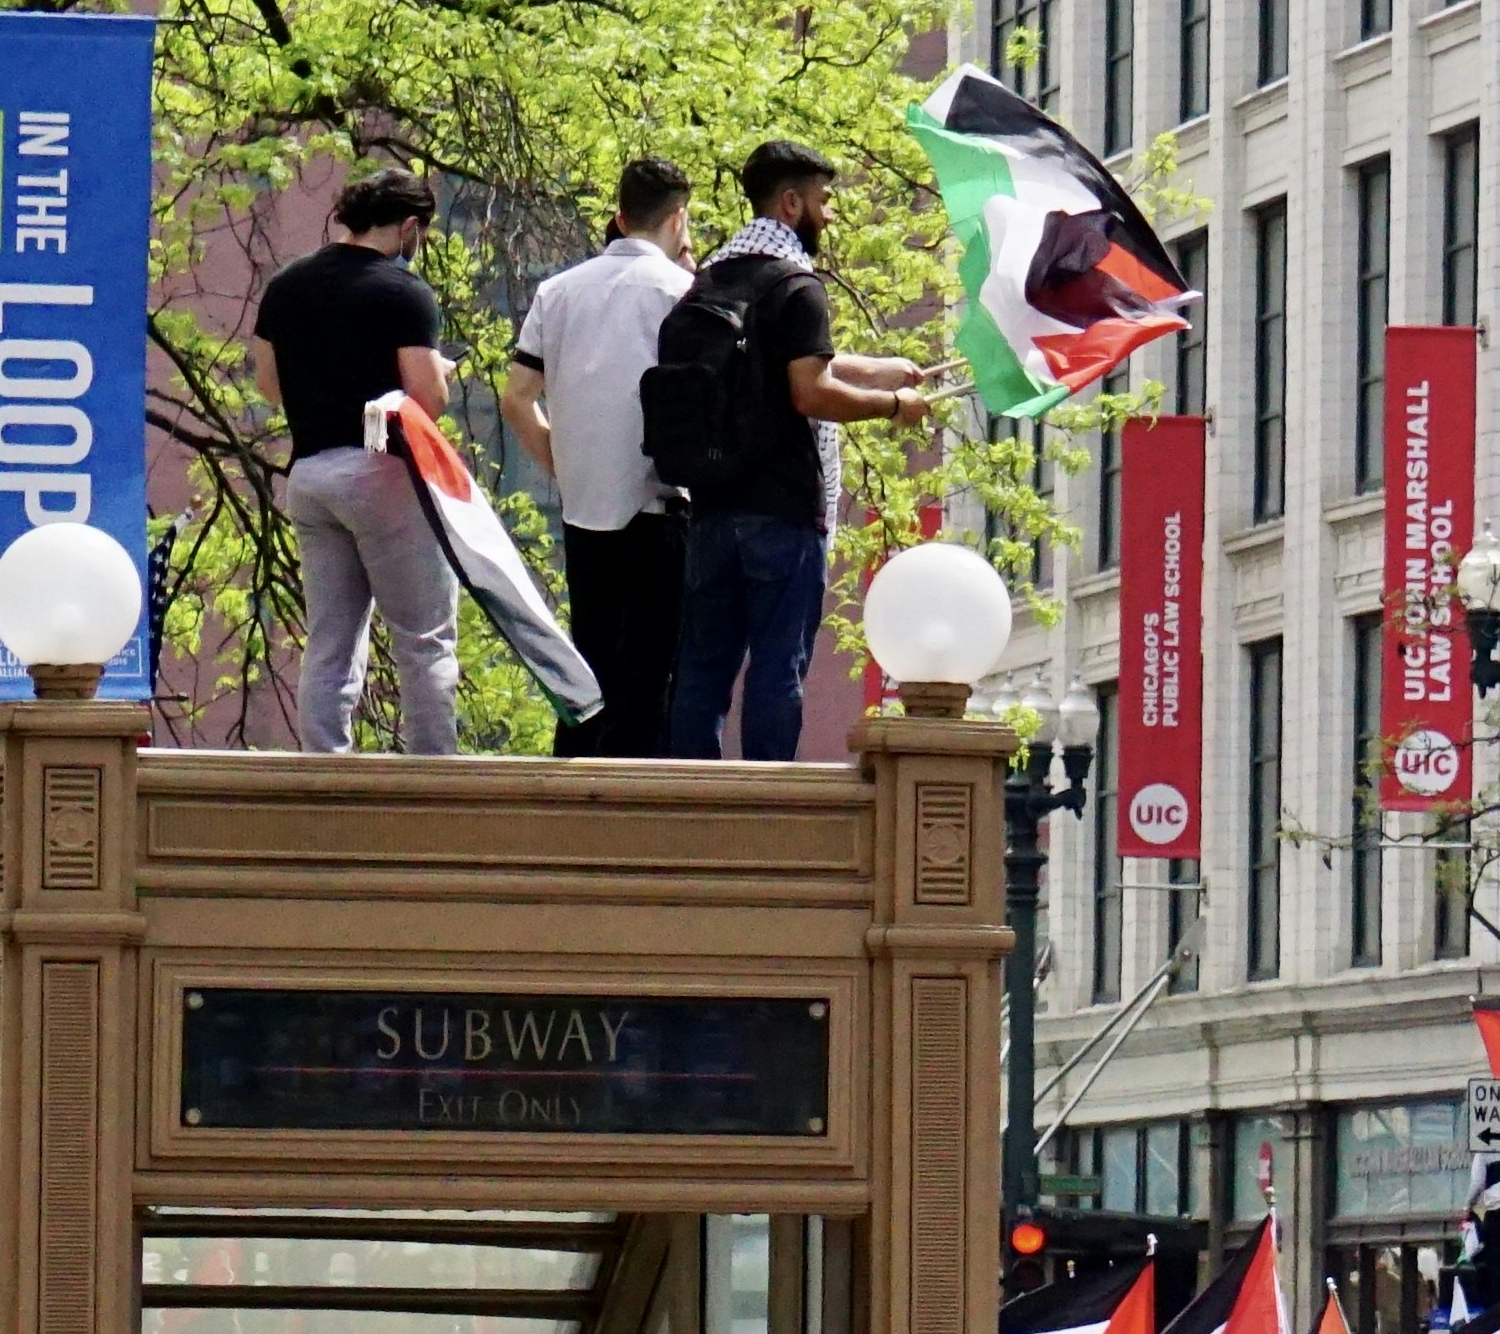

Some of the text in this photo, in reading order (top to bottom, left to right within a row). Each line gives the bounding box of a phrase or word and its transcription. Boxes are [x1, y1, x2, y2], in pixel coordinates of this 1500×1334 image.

[15, 110, 71, 255] IN THE
[1405, 379, 1430, 553] MARSHALL
[1162, 511, 1182, 727] PUBLIC LAW SCHOOL
[1142, 612, 1160, 727] CHICAGO'S
[1403, 647, 1426, 701] UIC
[1429, 637, 1452, 702] LAW
[1401, 754, 1451, 776] UIC
[1135, 804, 1183, 825] UIC
[376, 1006, 631, 1063] SUBWAY
